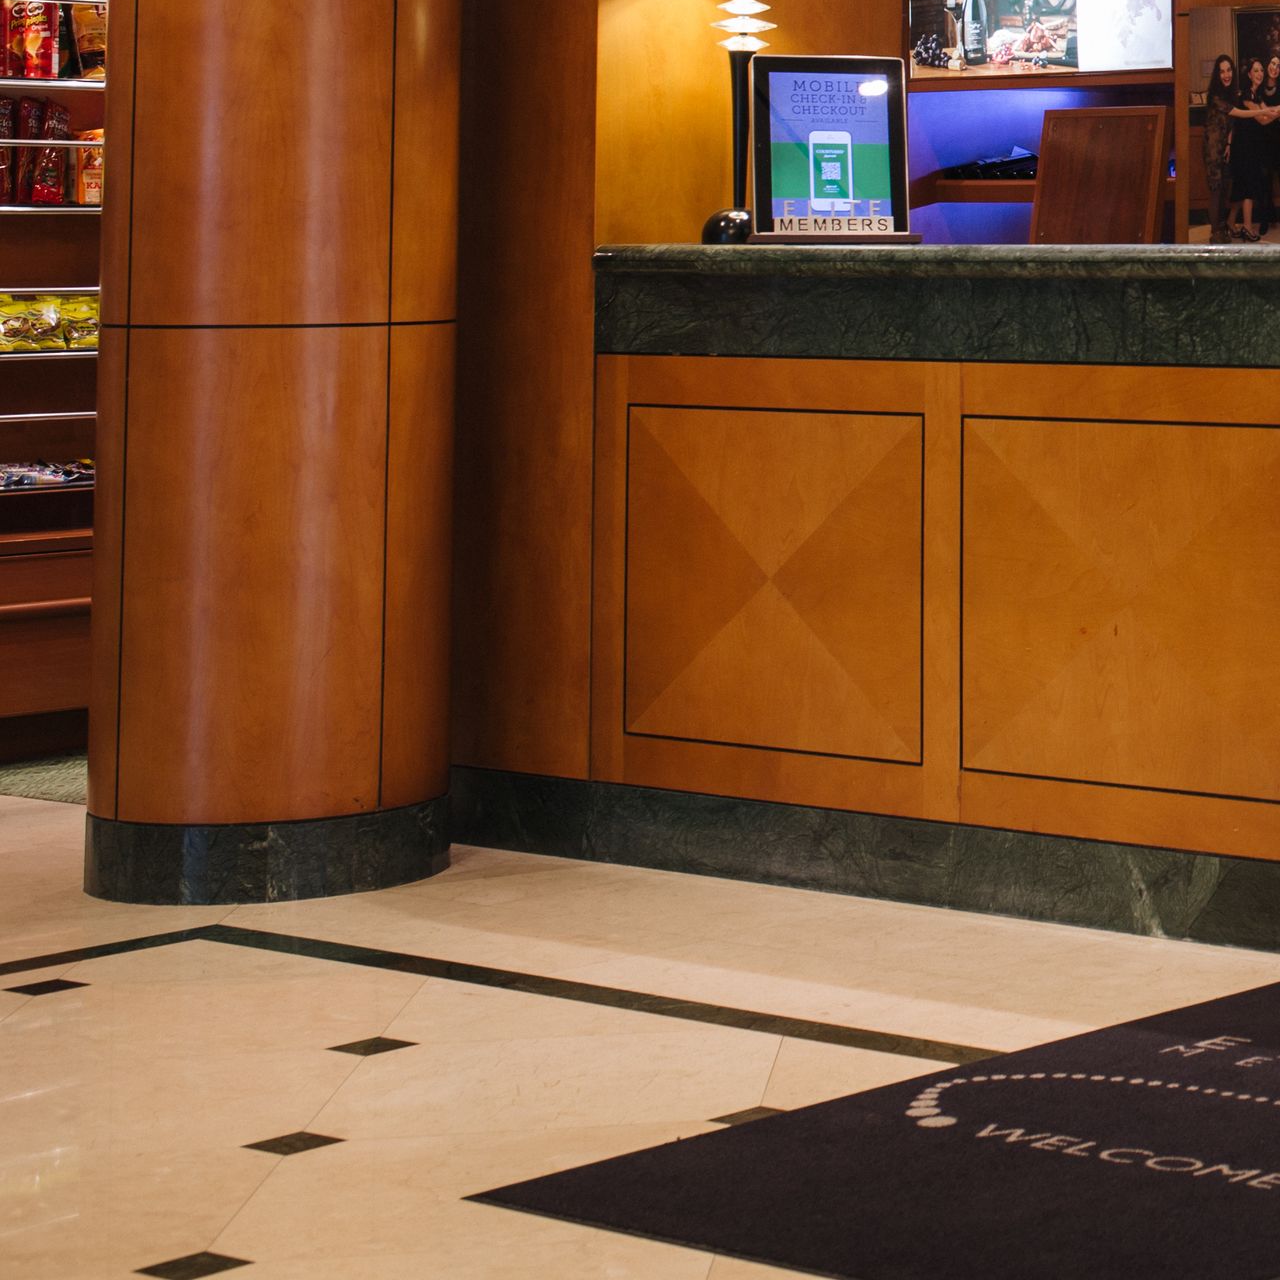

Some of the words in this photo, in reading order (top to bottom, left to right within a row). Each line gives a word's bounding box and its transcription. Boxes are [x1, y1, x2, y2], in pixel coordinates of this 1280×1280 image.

[790, 94, 856, 104] CHECK-IN
[792, 105, 866, 115] CHECKOUT
[784, 201, 881, 217] ELITE
[780, 219, 888, 231] MEMBERS
